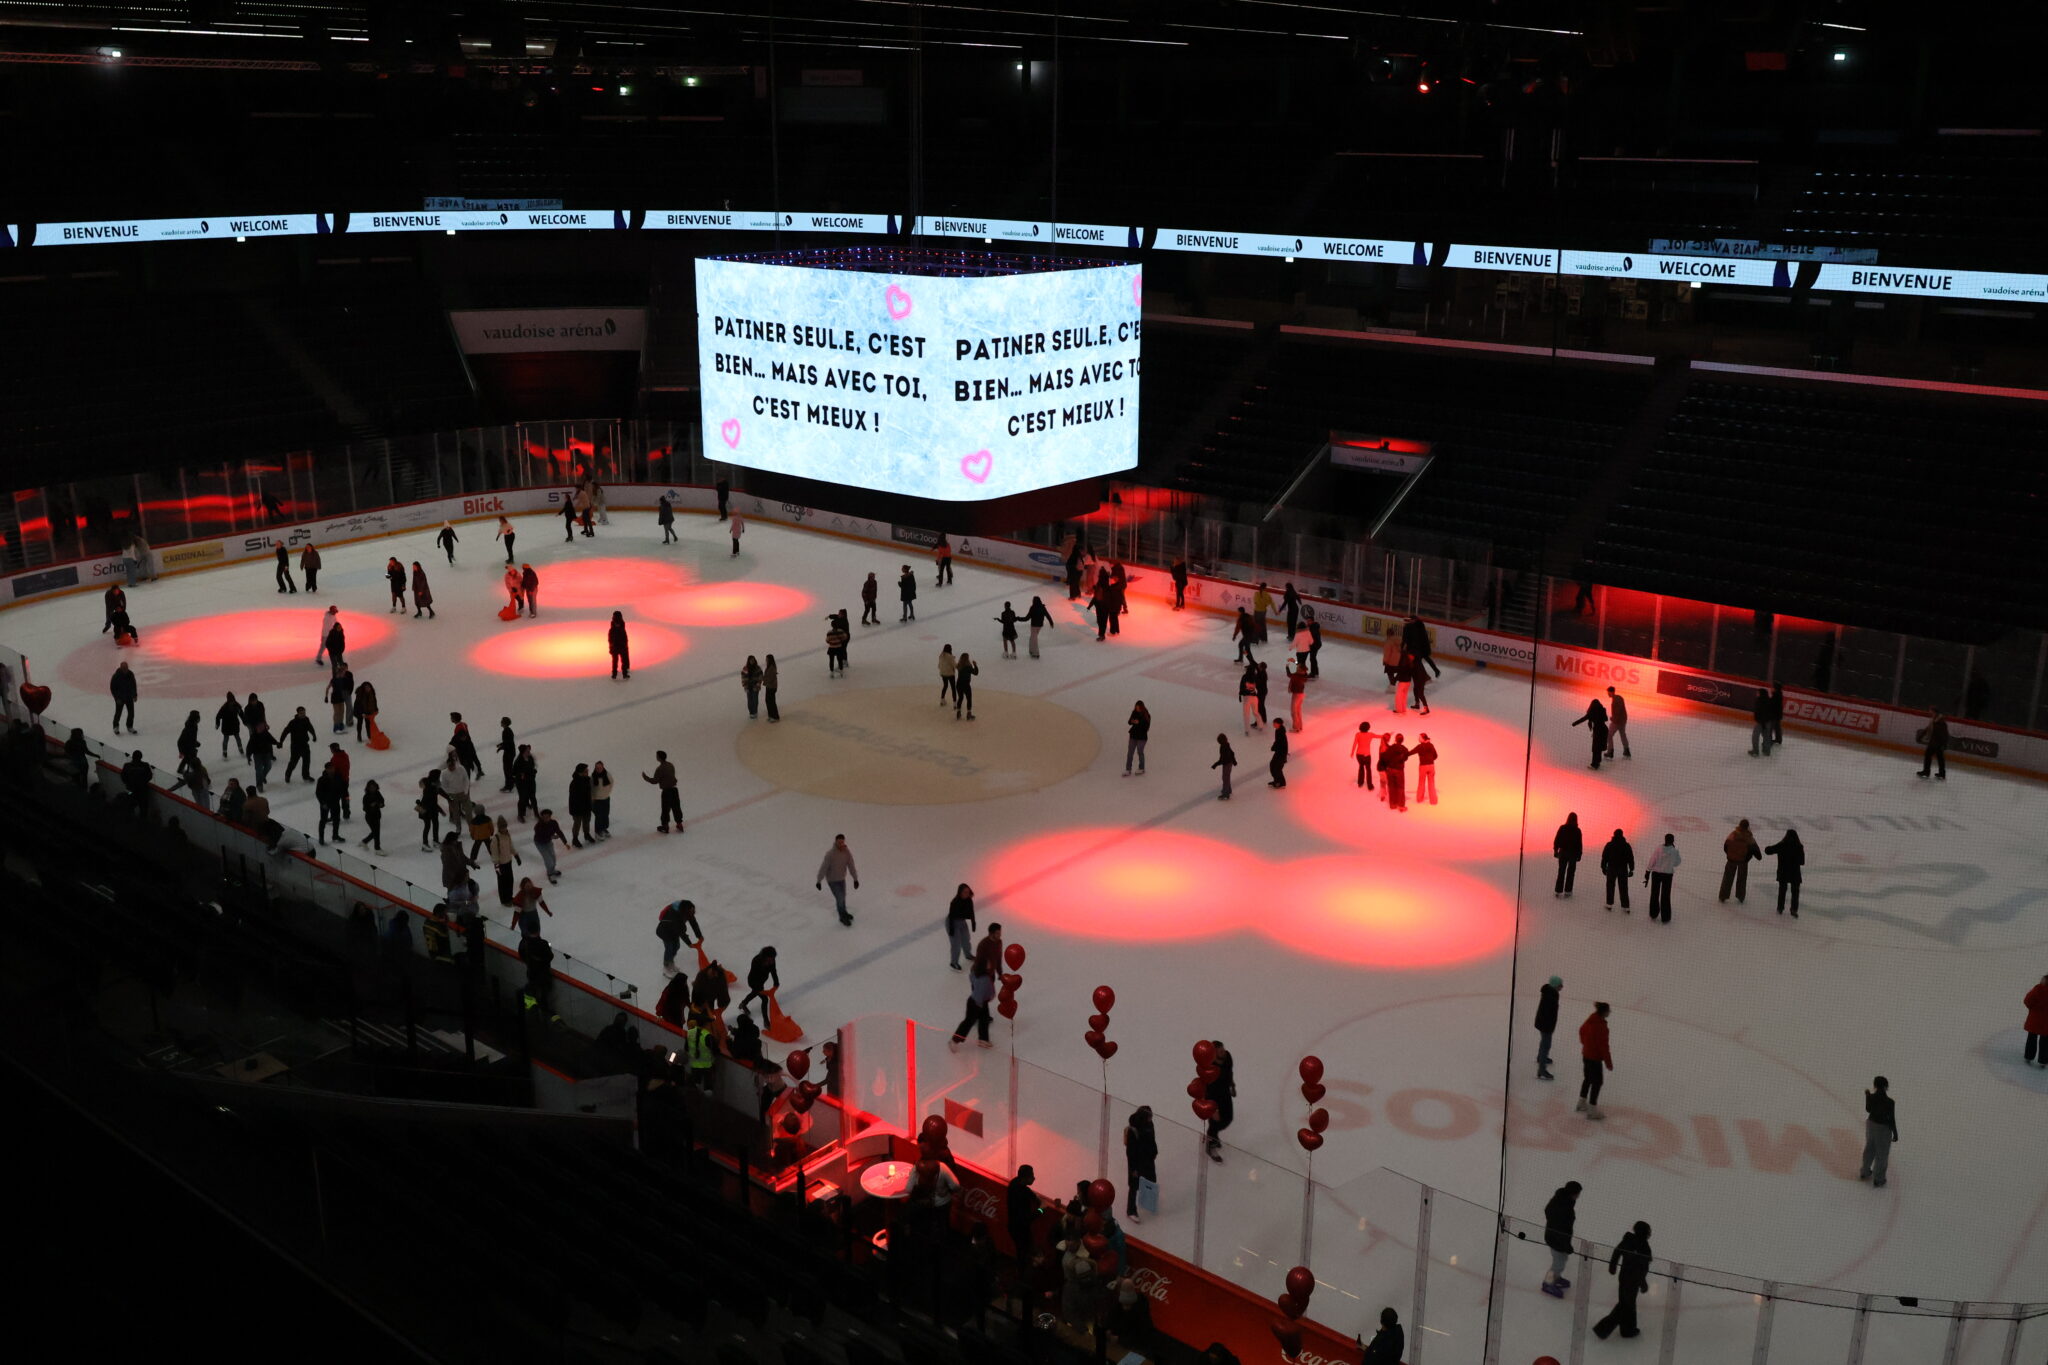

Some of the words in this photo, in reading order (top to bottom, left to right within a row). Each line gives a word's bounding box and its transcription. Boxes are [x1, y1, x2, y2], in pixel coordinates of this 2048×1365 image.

[230, 219, 288, 232] WELCOME
[373, 215, 441, 227] BIENVENUE
[529, 214, 587, 225] WELCOME
[667, 214, 732, 225] BIENVENUE
[811, 217, 864, 229] WELCOME
[63, 225, 139, 239] BIENVENUE
[934, 221, 987, 234] BIENVENUE
[1056, 227, 1104, 241] WELCOME
[1177, 234, 1239, 249] BIENVENUE
[1324, 242, 1384, 257] WELCOME
[1474, 250, 1552, 267] BIENVENUE
[1576, 262, 1603, 271] vaudoise
[1659, 260, 1736, 278] WELCOME
[1852, 271, 1952, 291] BIENVENUE
[1983, 286, 2020, 295] vaudoise
[483, 324, 555, 339] vaudoise
[560, 323, 603, 337] aréna
[715, 316, 786, 343] PATINER
[793, 325, 860, 354] SEUL.E,
[868, 333, 926, 358] C'EST
[956, 332, 1045, 361] PATINER
[1052, 325, 1112, 351] SEUL.E,
[1118, 320, 1141, 342] C'E
[715, 353, 765, 379] BIEN...
[772, 360, 818, 385] MAIS
[825, 367, 876, 393] AVEC
[883, 374, 927, 402] TOI,
[955, 377, 1022, 402] BIEN...
[1029, 368, 1073, 394] MAIS
[1080, 361, 1123, 386] AVEC
[753, 395, 800, 421] C'EST
[807, 403, 867, 431] MIEUX
[874, 412, 879, 433] !
[1008, 409, 1056, 436] C'EST
[1062, 399, 1114, 427] MIEUX
[1119, 397, 1124, 416] !
[464, 496, 504, 515] Blick
[163, 550, 206, 564] CARDINAL
[1473, 641, 1536, 661] NORWOOD
[1556, 655, 1640, 685] MIGROS
[1783, 701, 1878, 730] DENNER
[1961, 741, 1991, 755] VINS
